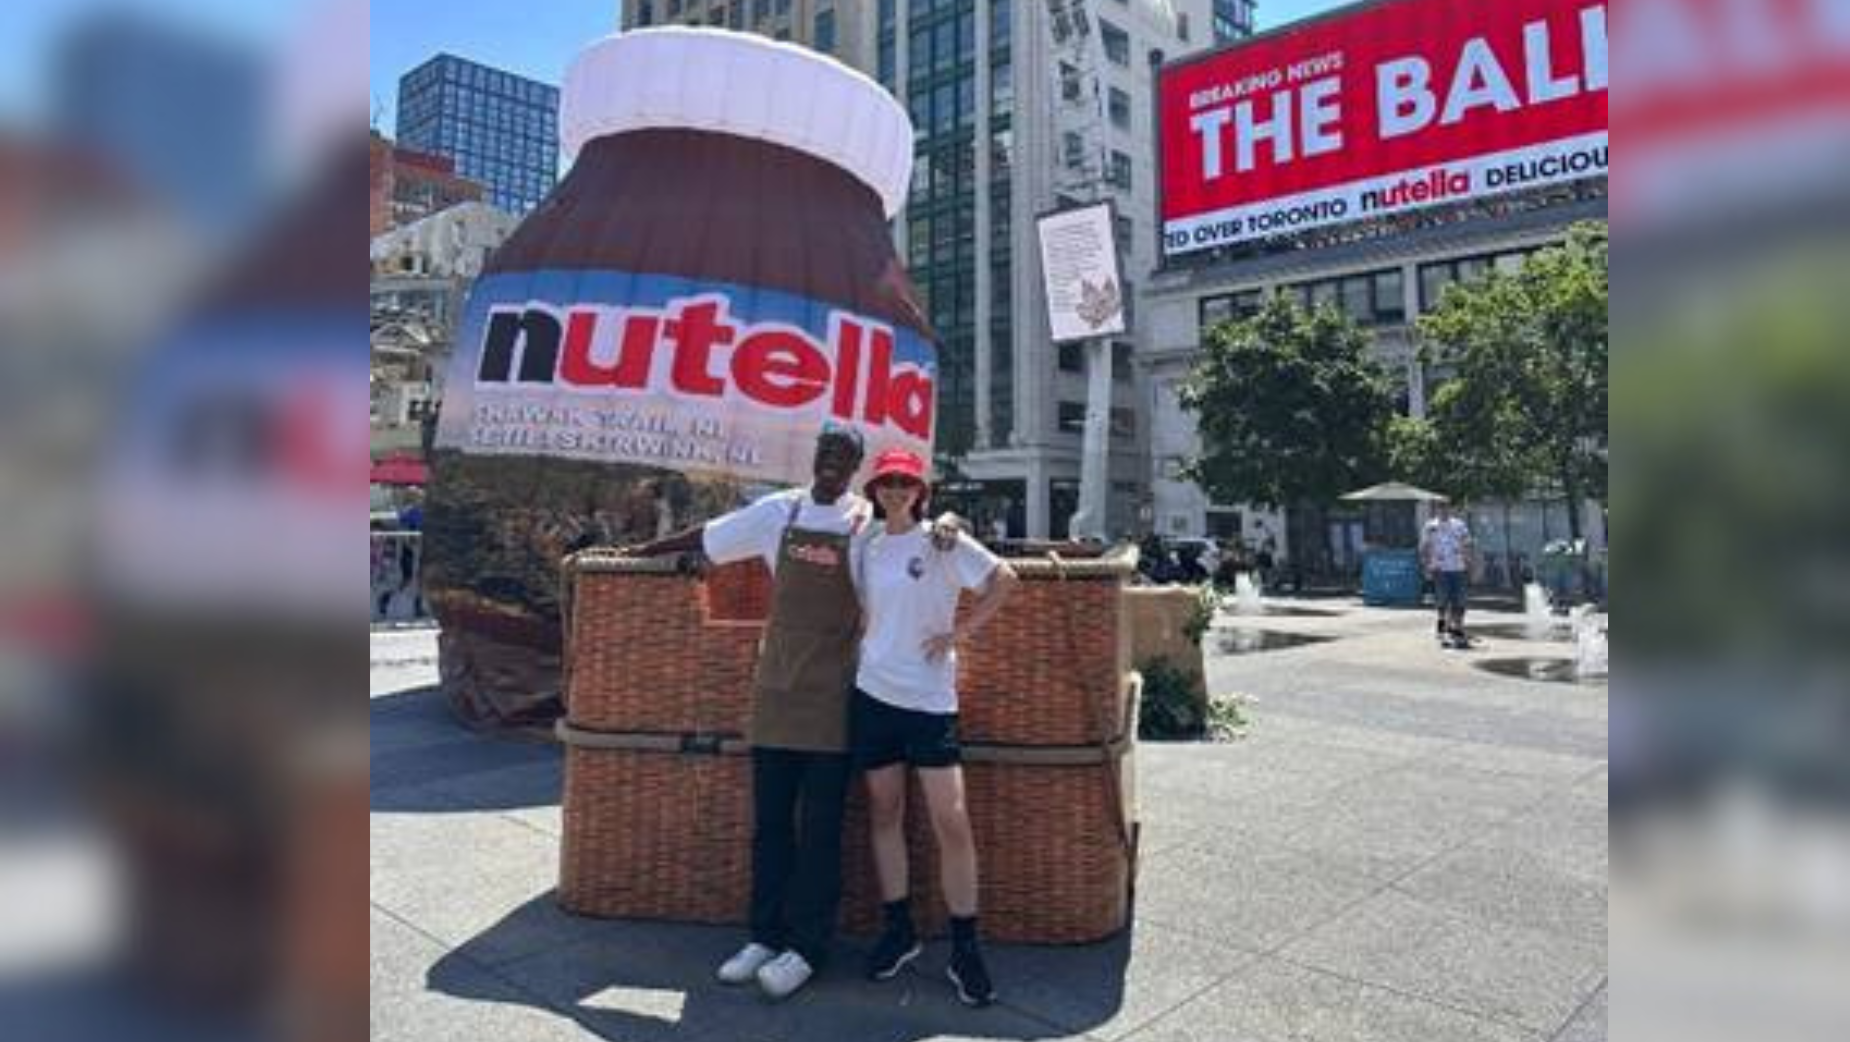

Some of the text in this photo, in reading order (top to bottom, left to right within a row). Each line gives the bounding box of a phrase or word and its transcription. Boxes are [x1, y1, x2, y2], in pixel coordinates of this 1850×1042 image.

[1190, 51, 1344, 109] BREAKING NEWS
[1190, 77, 1344, 181] THE
[1194, 219, 1242, 241] OVER
[1247, 198, 1347, 232] TORONTO
[1360, 170, 1471, 209] nutella
[478, 301, 934, 441] nutella
